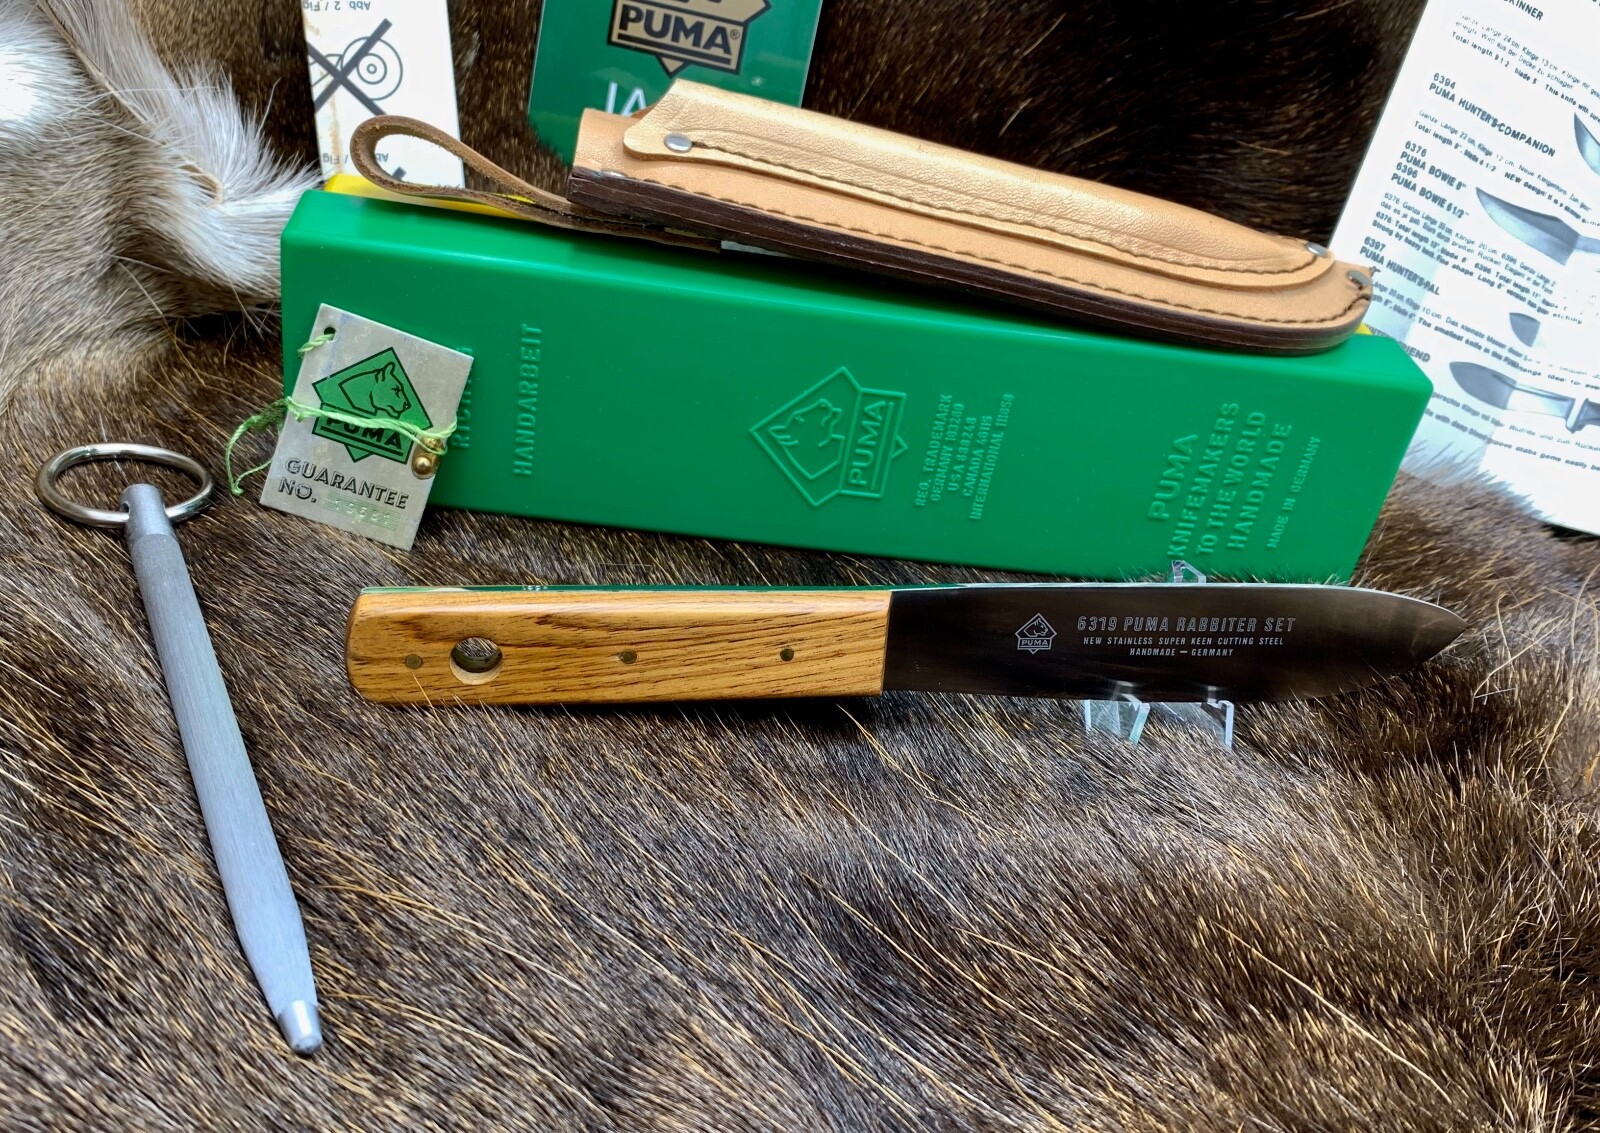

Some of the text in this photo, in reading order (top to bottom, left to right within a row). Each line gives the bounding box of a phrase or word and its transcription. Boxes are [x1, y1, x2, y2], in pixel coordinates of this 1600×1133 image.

[618, 2, 732, 56] PUMA
[1428, 82, 1456, 102] PUMA
[1433, 72, 1456, 90] 6394
[1404, 139, 1427, 157] 6376
[1395, 161, 1419, 179] 6396
[1399, 149, 1427, 171] PUMA
[1427, 164, 1456, 186] BOWIE
[1504, 171, 1521, 183] NEW
[1390, 172, 1418, 192] PUMA
[1418, 186, 1447, 208] BOWIE
[1359, 246, 1385, 266] PUMA
[1364, 236, 1386, 252] 6397
[1417, 317, 1432, 327] The
[512, 322, 543, 478] HANDARBEIT
[848, 400, 887, 487] PUMA
[914, 394, 952, 507] REG. TRADEMARK
[278, 477, 317, 504] NO.
[285, 457, 409, 510] GUARANTEE
[930, 445, 955, 502] GERMANY
[947, 463, 966, 492] USA
[961, 449, 985, 498] CANADA
[969, 431, 1005, 521] INTERNATIONAL
[1148, 434, 1199, 520] PUMA
[1167, 402, 1240, 558] KNIFEMAKERS
[1197, 411, 1266, 555] TO THE WORLD
[1227, 424, 1293, 549] HANDMADE
[1266, 436, 1321, 549] MADE IN GERMANY
[1077, 616, 1297, 632] 6319 PUMA RABBITER SET
[1083, 637, 1284, 645] NEW STAINLESS SUPER KEEN CUTTING STEEL
[1021, 639, 1048, 647] PUMA
[1129, 648, 1176, 657] HANDMADE
[1191, 648, 1234, 657] GERMANY
